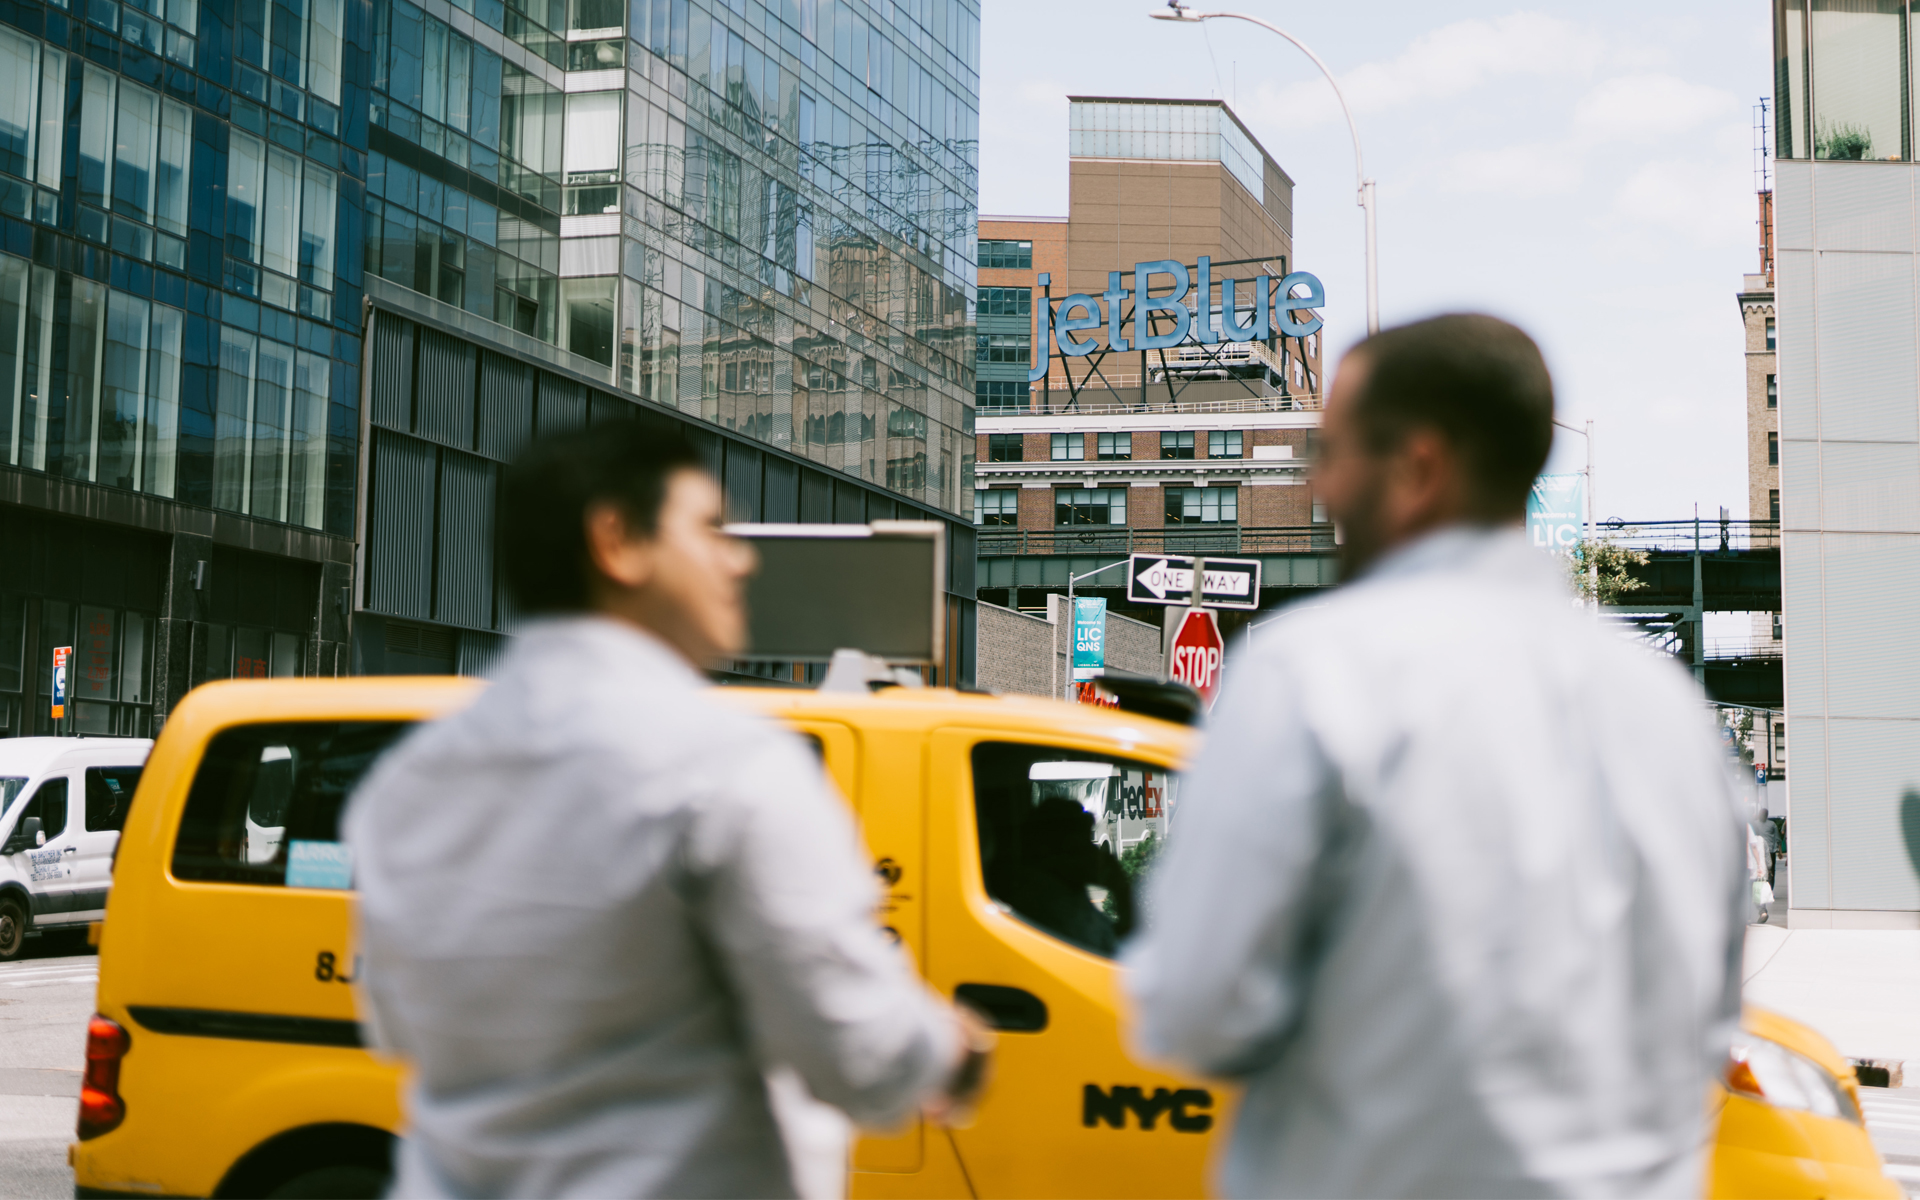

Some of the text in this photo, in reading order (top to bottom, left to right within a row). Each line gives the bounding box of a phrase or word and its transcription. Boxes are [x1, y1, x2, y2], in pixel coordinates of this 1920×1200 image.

[1028, 255, 1325, 382] jetBlue
[1532, 511, 1577, 519] Welcome to
[1533, 523, 1578, 547] LIC
[1150, 570, 1240, 591] ONE WAY
[1077, 627, 1102, 641] LIC
[1076, 642, 1100, 652] QNS
[87, 665, 109, 680] 2,797
[237, 656, 267, 680] 招商
[1173, 645, 1219, 688] STOP
[1120, 769, 1163, 820] FedEx
[1082, 1084, 1214, 1134] NYC
